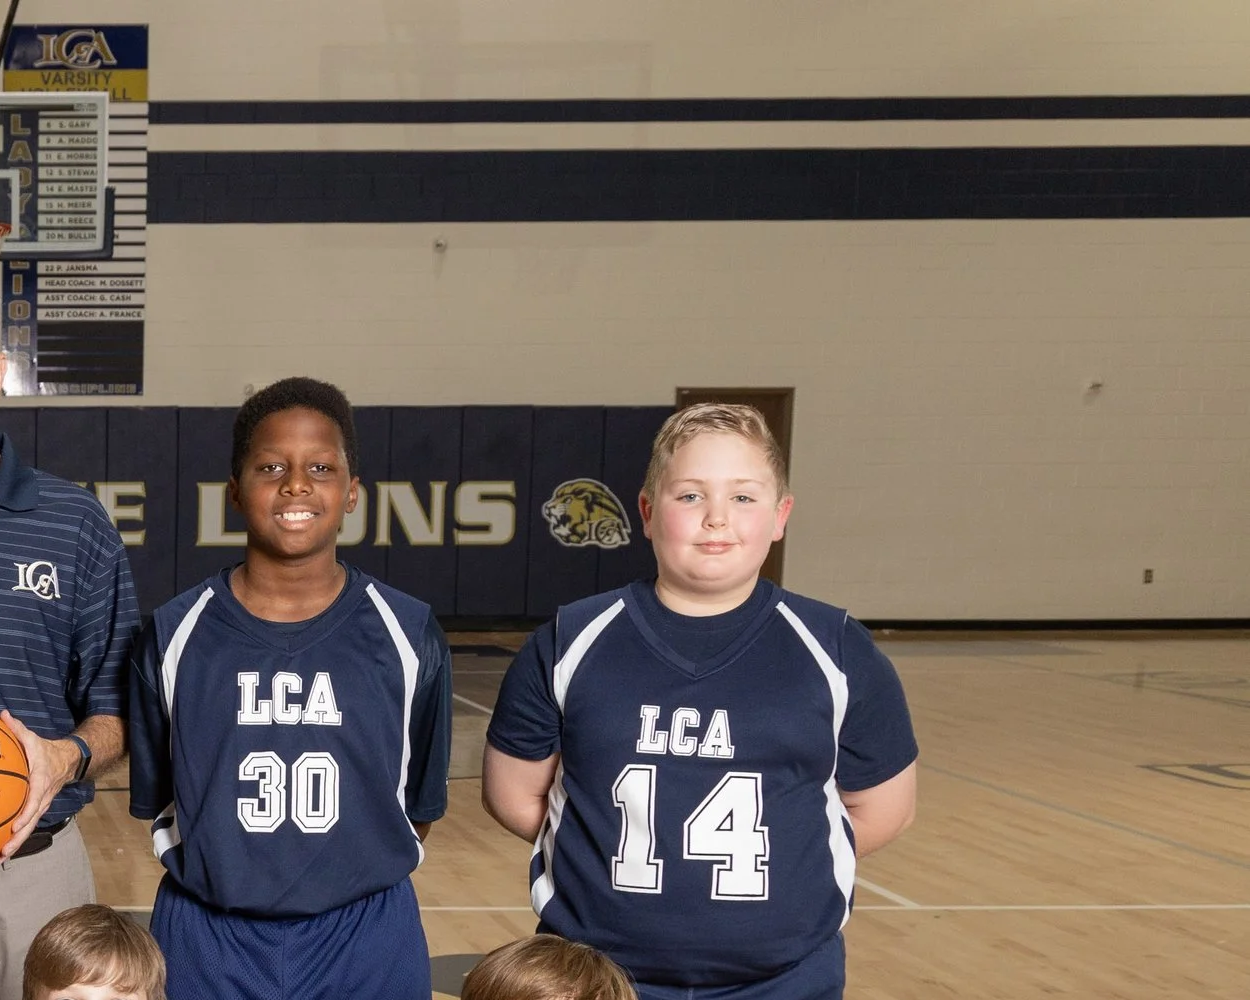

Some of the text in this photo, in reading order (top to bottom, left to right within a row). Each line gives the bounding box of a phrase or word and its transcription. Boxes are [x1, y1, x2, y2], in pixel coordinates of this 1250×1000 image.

[40, 71, 112, 85] VARSITY
[45, 264, 55, 272] 22
[196, 480, 517, 547] LNS
[237, 671, 342, 726] LCA
[636, 704, 735, 759] LCA
[237, 751, 339, 834] 30
[611, 764, 770, 901] 14
